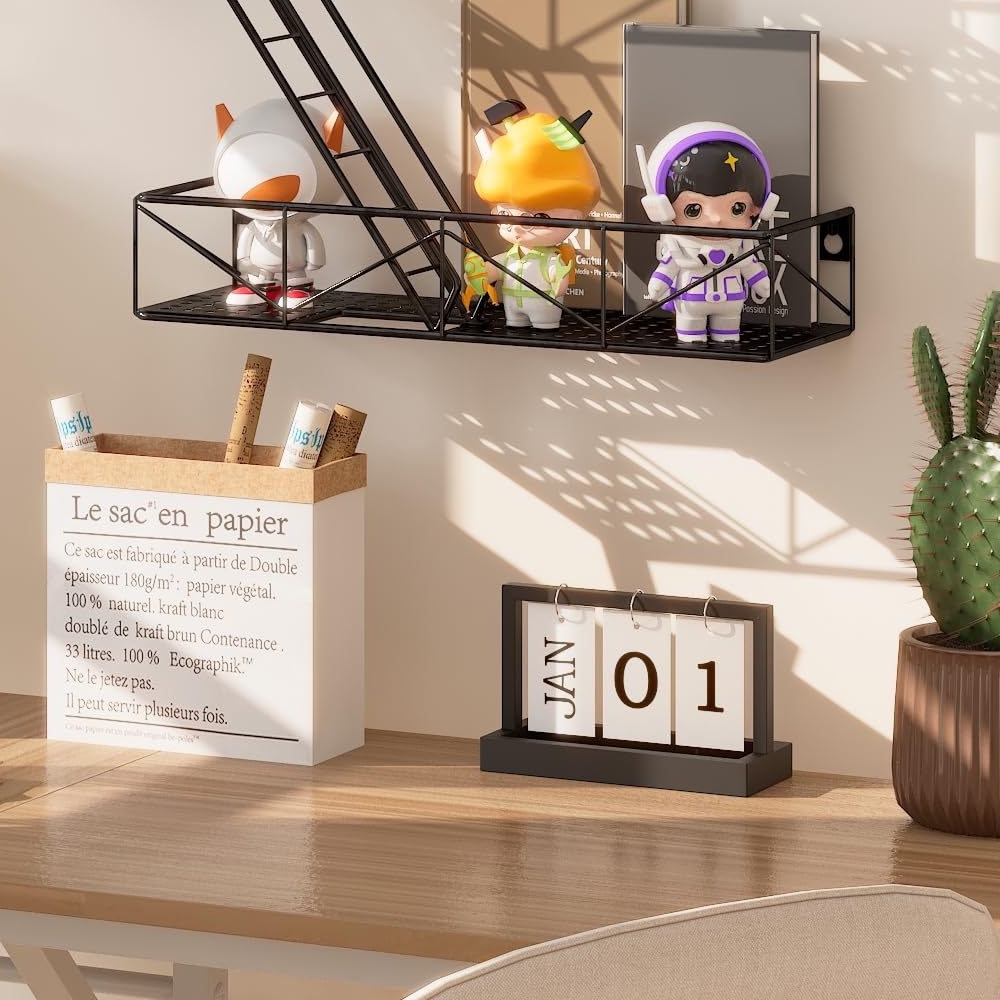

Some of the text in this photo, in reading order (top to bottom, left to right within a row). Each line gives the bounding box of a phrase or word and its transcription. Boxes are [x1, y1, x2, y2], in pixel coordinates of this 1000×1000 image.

[72, 496, 102, 521] Le
[109, 503, 147, 524] sac
[158, 507, 188, 527] en
[206, 507, 288, 540] papier
[64, 541, 298, 575] Ce sac est fabriqué à partir de Double
[64, 567, 120, 587] épaisseur
[186, 579, 226, 599] papier
[229, 582, 276, 602] végétal.
[65, 592, 86, 608] 100
[90, 595, 102, 609] %
[159, 599, 187, 616] kraft
[190, 602, 224, 620] blanc
[65, 617, 108, 636] doublé
[114, 621, 129, 637] de
[135, 621, 164, 640] kraft
[167, 625, 197, 643] brun
[65, 644, 80, 659] 33
[83, 645, 116, 662] litres.
[123, 648, 144, 663] 100
[147, 650, 160, 665] %
[65, 667, 155, 693] Ne le jetez pas.
[543, 636, 576, 719] JAN
[66, 693, 228, 725] Il peut servir plusieurs fois.
